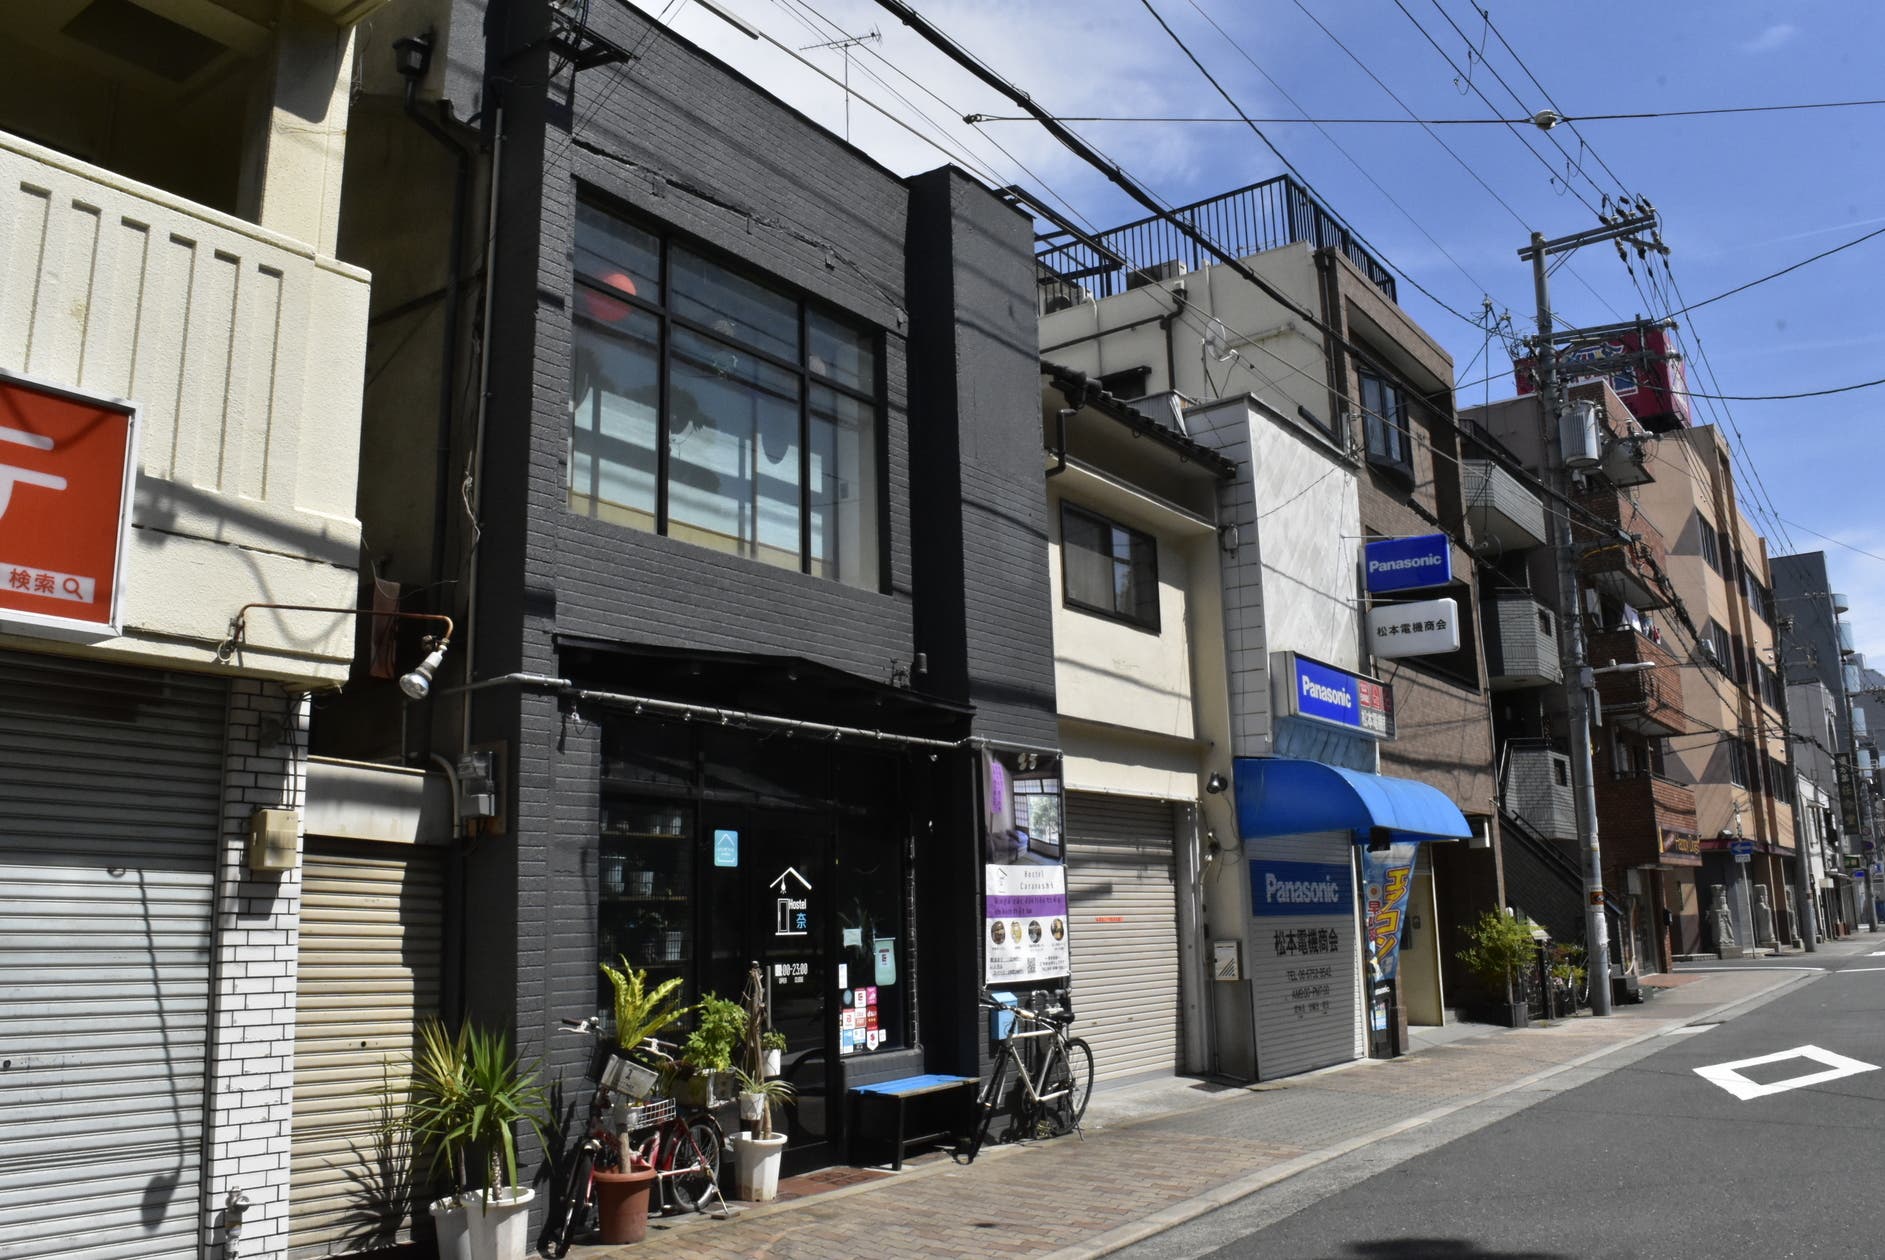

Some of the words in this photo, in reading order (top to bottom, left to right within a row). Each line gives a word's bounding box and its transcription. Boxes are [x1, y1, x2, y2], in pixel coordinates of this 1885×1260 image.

[1369, 554, 1441, 573] Panasonic
[9, 567, 56, 595] 検索
[1376, 618, 1447, 637] 松本電機商会
[1302, 675, 1351, 708] Panasonic
[1265, 873, 1339, 904] Panasonic
[788, 897, 807, 911] Hostel
[795, 912, 807, 929] 奈
[1274, 928, 1339, 957] 松本電機商会
